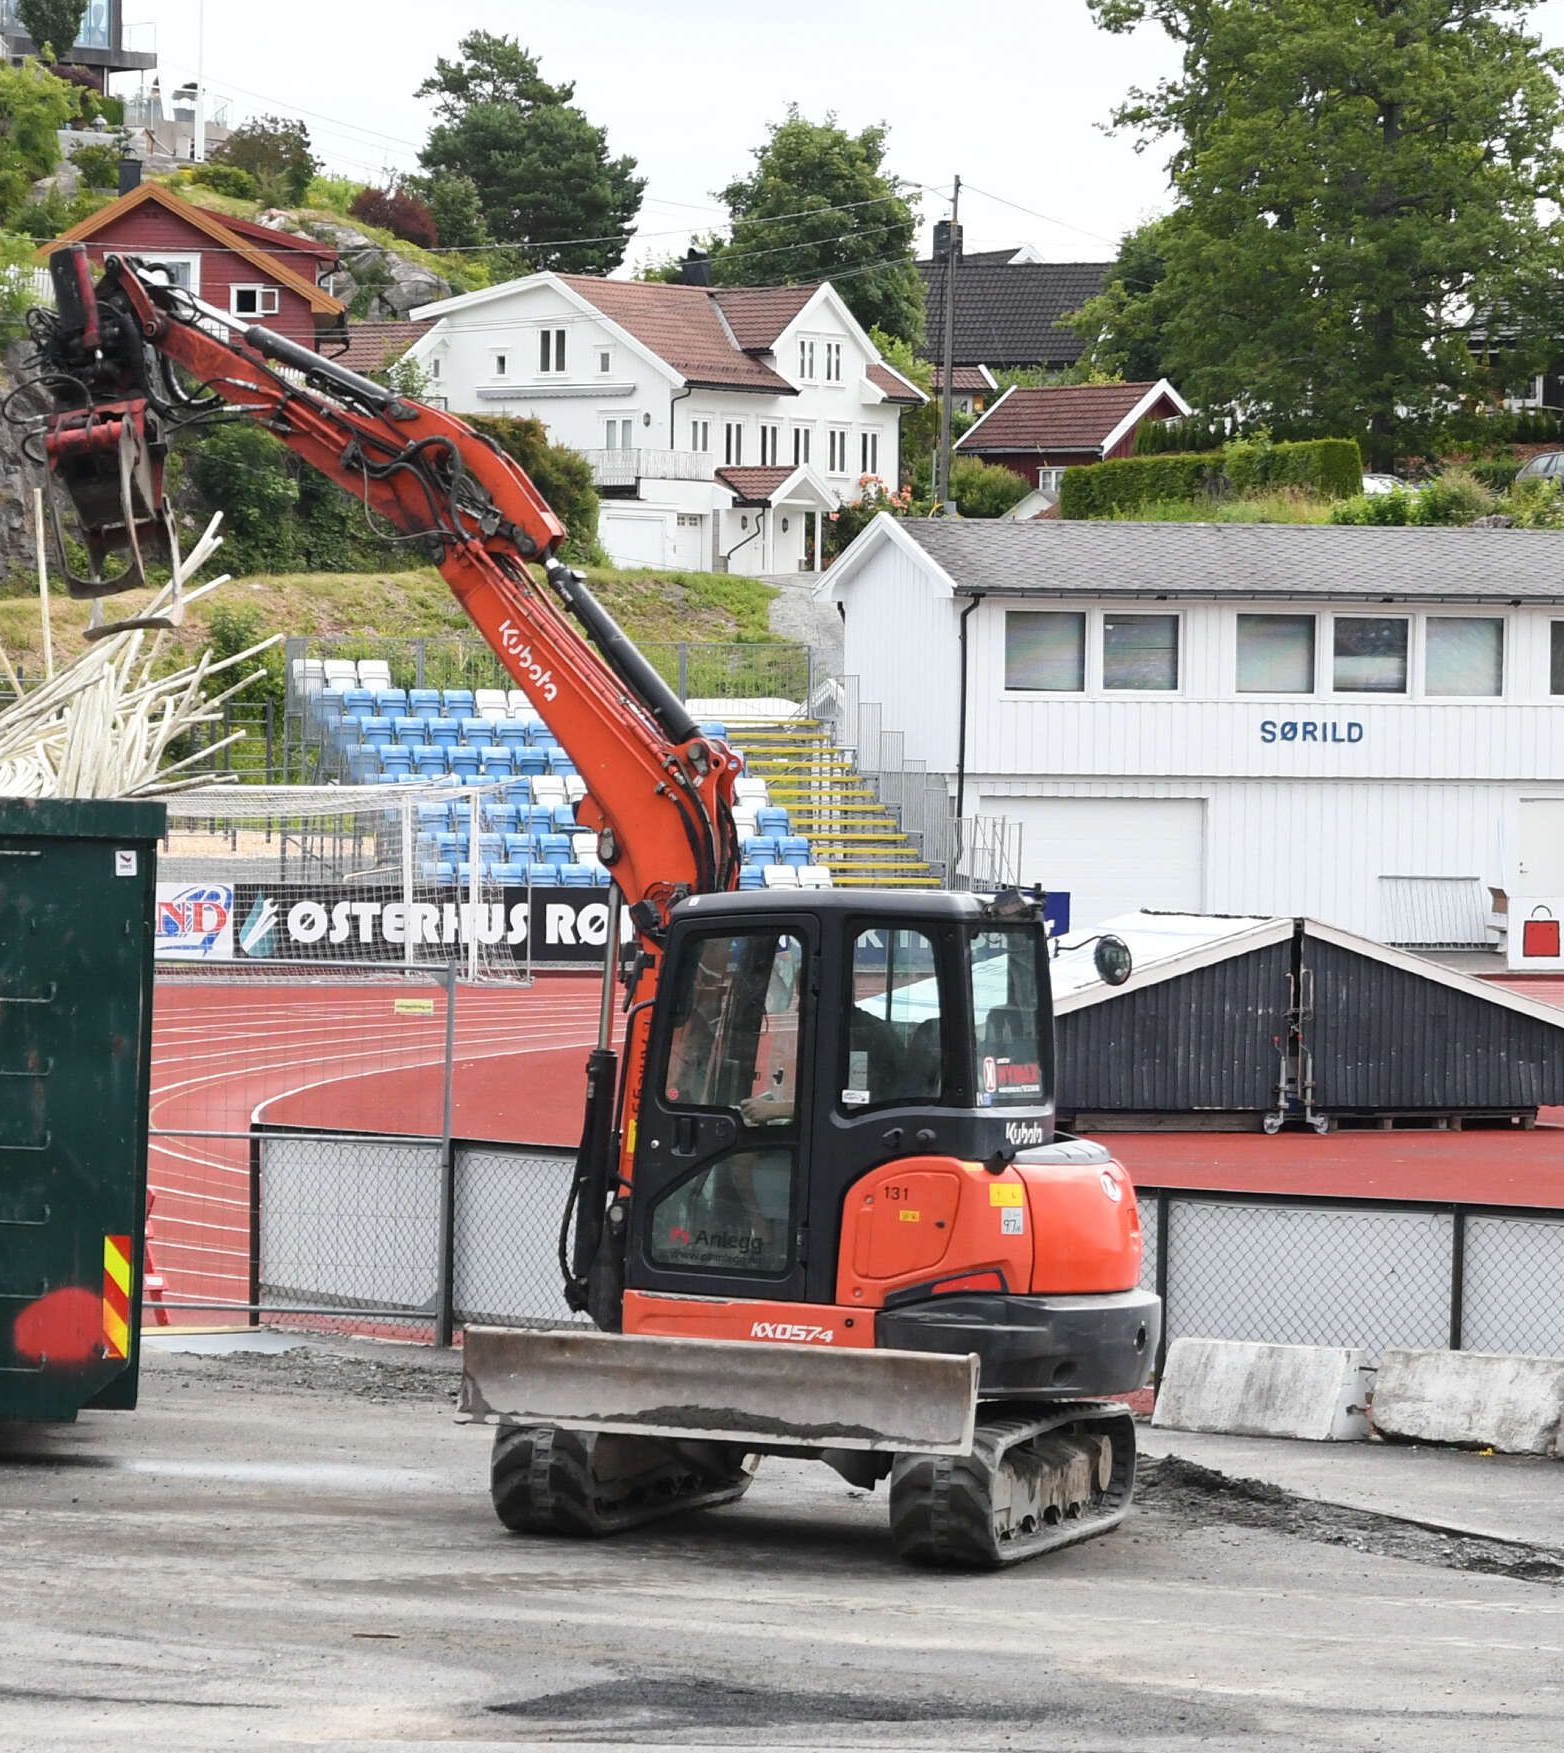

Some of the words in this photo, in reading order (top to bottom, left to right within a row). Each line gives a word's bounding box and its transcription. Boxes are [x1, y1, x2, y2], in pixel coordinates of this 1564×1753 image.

[498, 619, 557, 702] Kubota
[1260, 720, 1364, 743] SØRILD
[287, 900, 530, 945] ØSTERHUS
[1005, 1120, 1043, 1145] Kubota
[884, 1186, 909, 1201] 131
